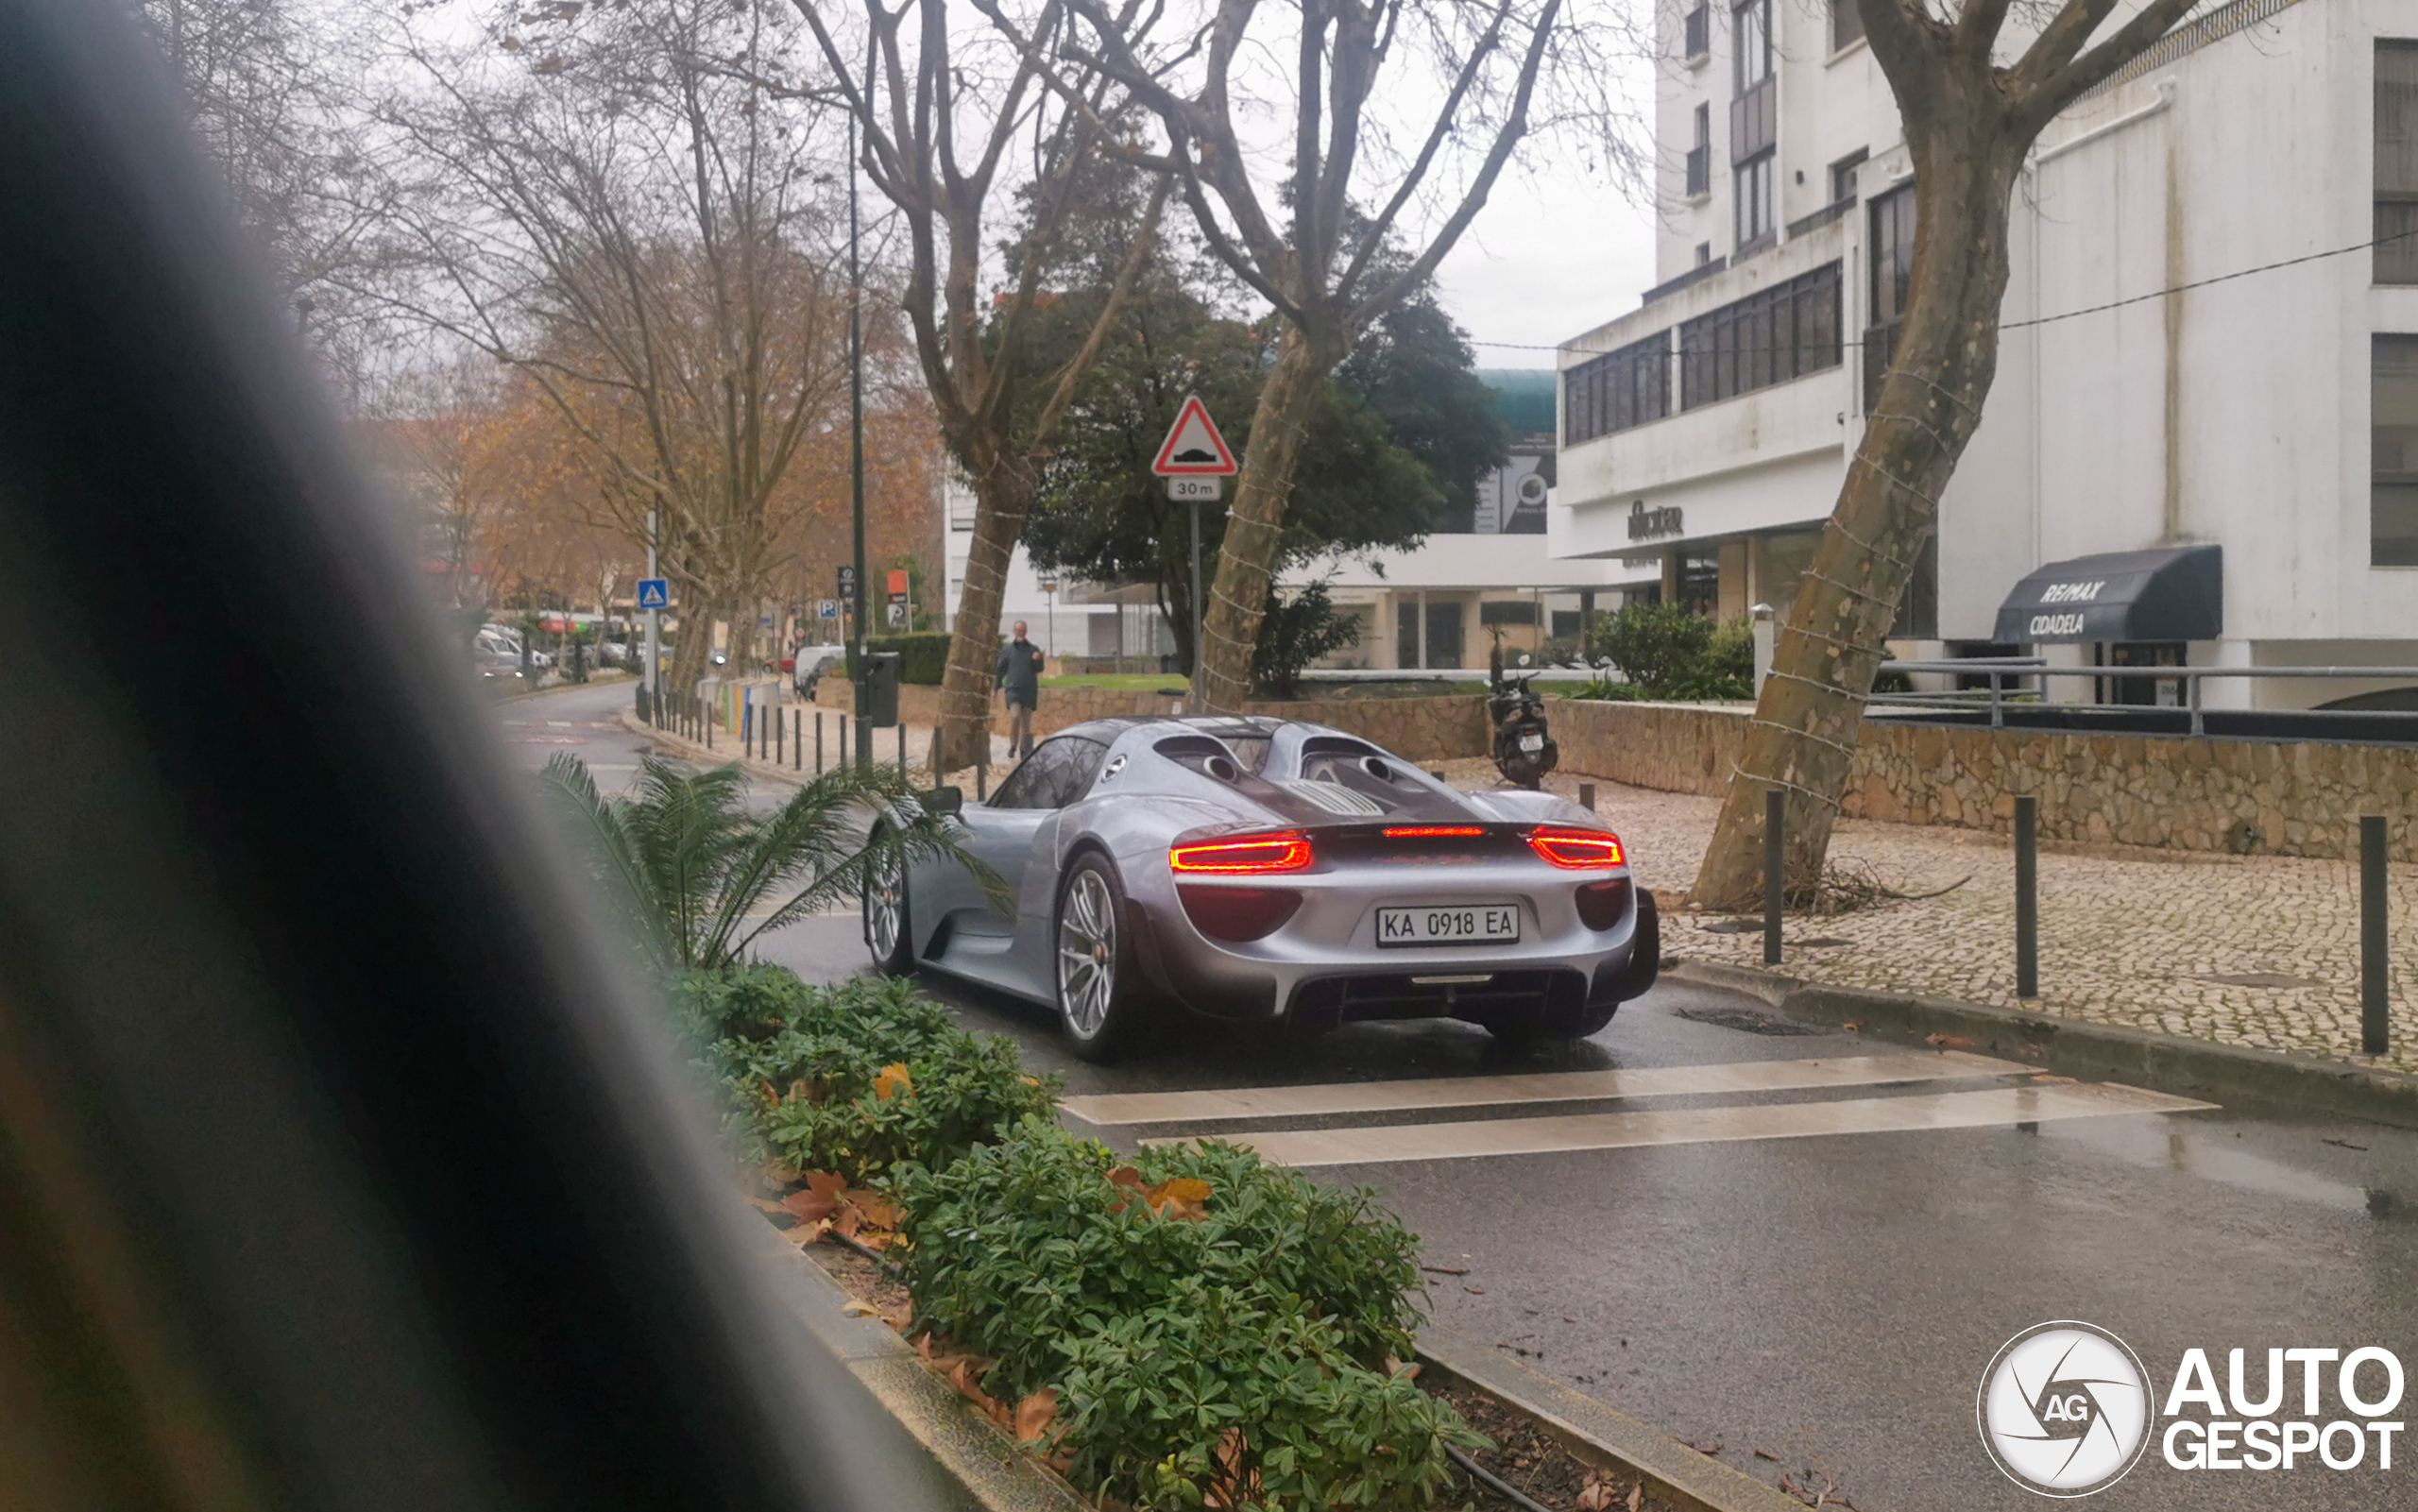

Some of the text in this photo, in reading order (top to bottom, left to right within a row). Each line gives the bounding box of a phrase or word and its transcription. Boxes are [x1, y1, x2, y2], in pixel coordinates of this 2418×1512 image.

[1177, 482, 1214, 495] 30 m
[2039, 580, 2106, 603] RE/MAX
[2029, 612, 2084, 636] CIDADELA
[1385, 910, 1512, 937] KA 0918 EA
